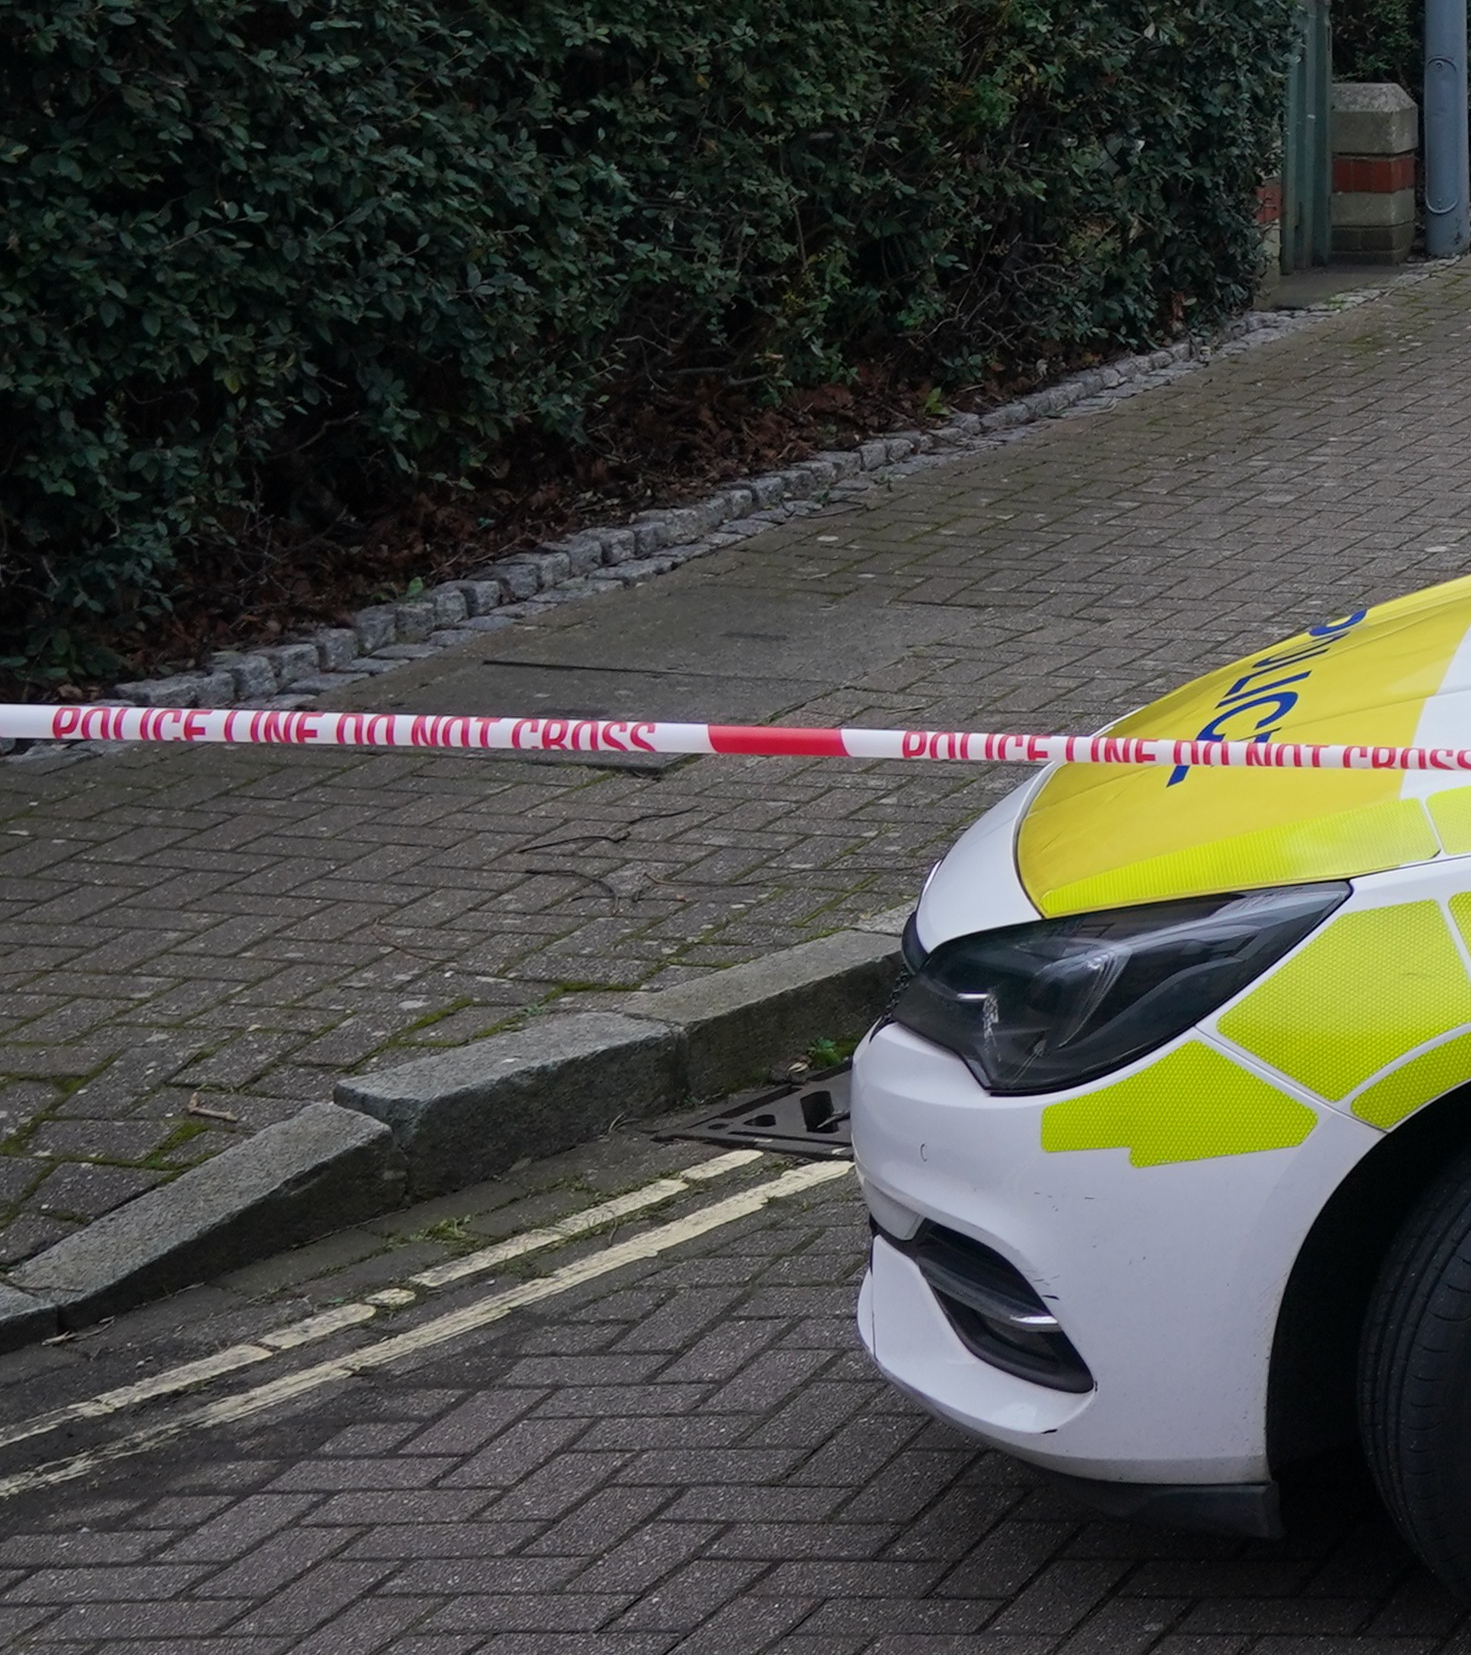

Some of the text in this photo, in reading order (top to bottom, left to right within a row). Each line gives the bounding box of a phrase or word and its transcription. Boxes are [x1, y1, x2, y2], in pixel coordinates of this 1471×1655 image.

[51, 706, 213, 742] POLICE
[336, 712, 396, 746] DO
[410, 714, 501, 748] NOT
[511, 718, 657, 753] CROSS
[901, 730, 1051, 762] POLICE
[1173, 739, 1230, 767] DO
[1245, 741, 1331, 768] NOT
